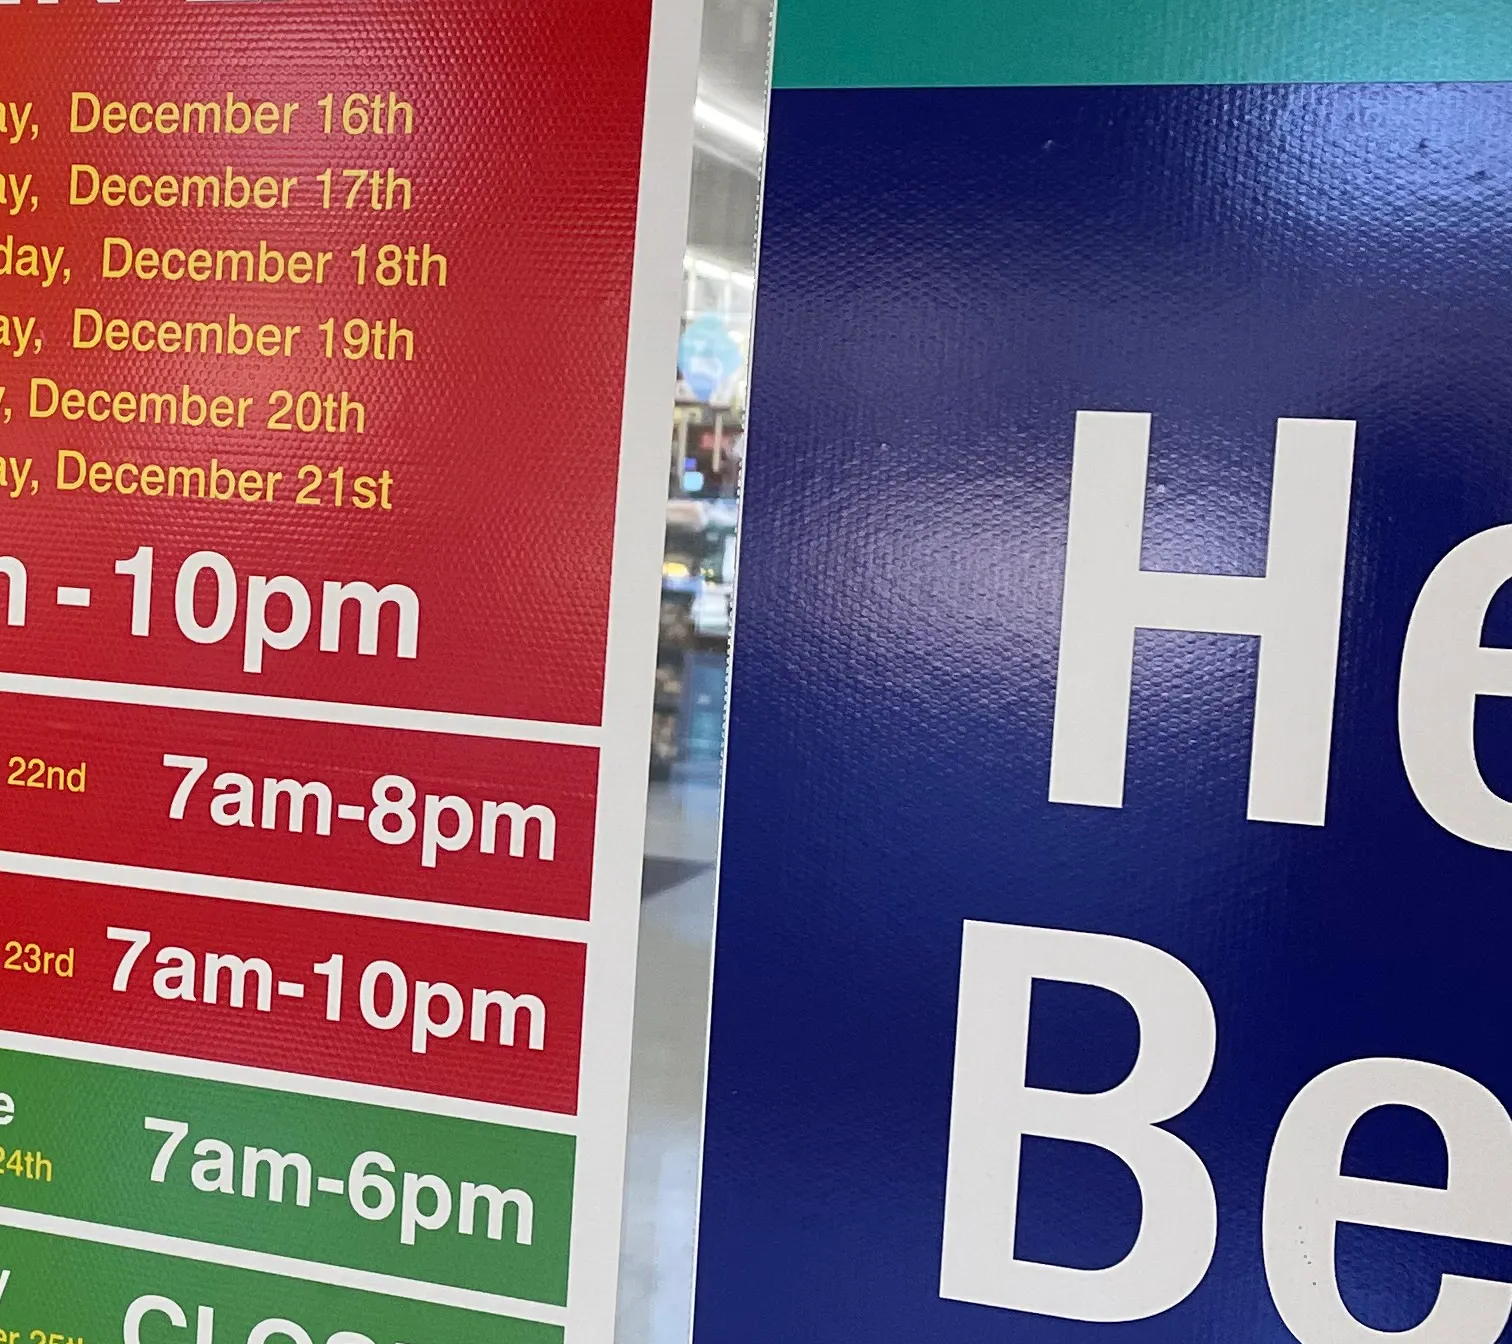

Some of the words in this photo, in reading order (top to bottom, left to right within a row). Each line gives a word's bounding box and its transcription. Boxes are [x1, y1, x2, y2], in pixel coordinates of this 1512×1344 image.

[70, 92, 299, 137] December
[316, 91, 414, 138] 16th
[70, 165, 296, 209] December
[314, 167, 411, 210] 17th
[103, 237, 332, 283] December
[351, 244, 446, 286] 18th
[73, 308, 301, 360] December
[319, 318, 413, 360] 19th
[30, 378, 253, 428] December
[266, 387, 364, 433] 20th
[57, 450, 282, 502] December
[295, 465, 393, 509] 21st
[115, 546, 419, 673] 10pm
[8, 757, 85, 792] 22nd
[164, 754, 555, 867] 7am-8pm
[4, 941, 74, 977] 23rd
[107, 927, 545, 1053] 7am-10pm
[145, 1117, 533, 1245] 7am-6pm
